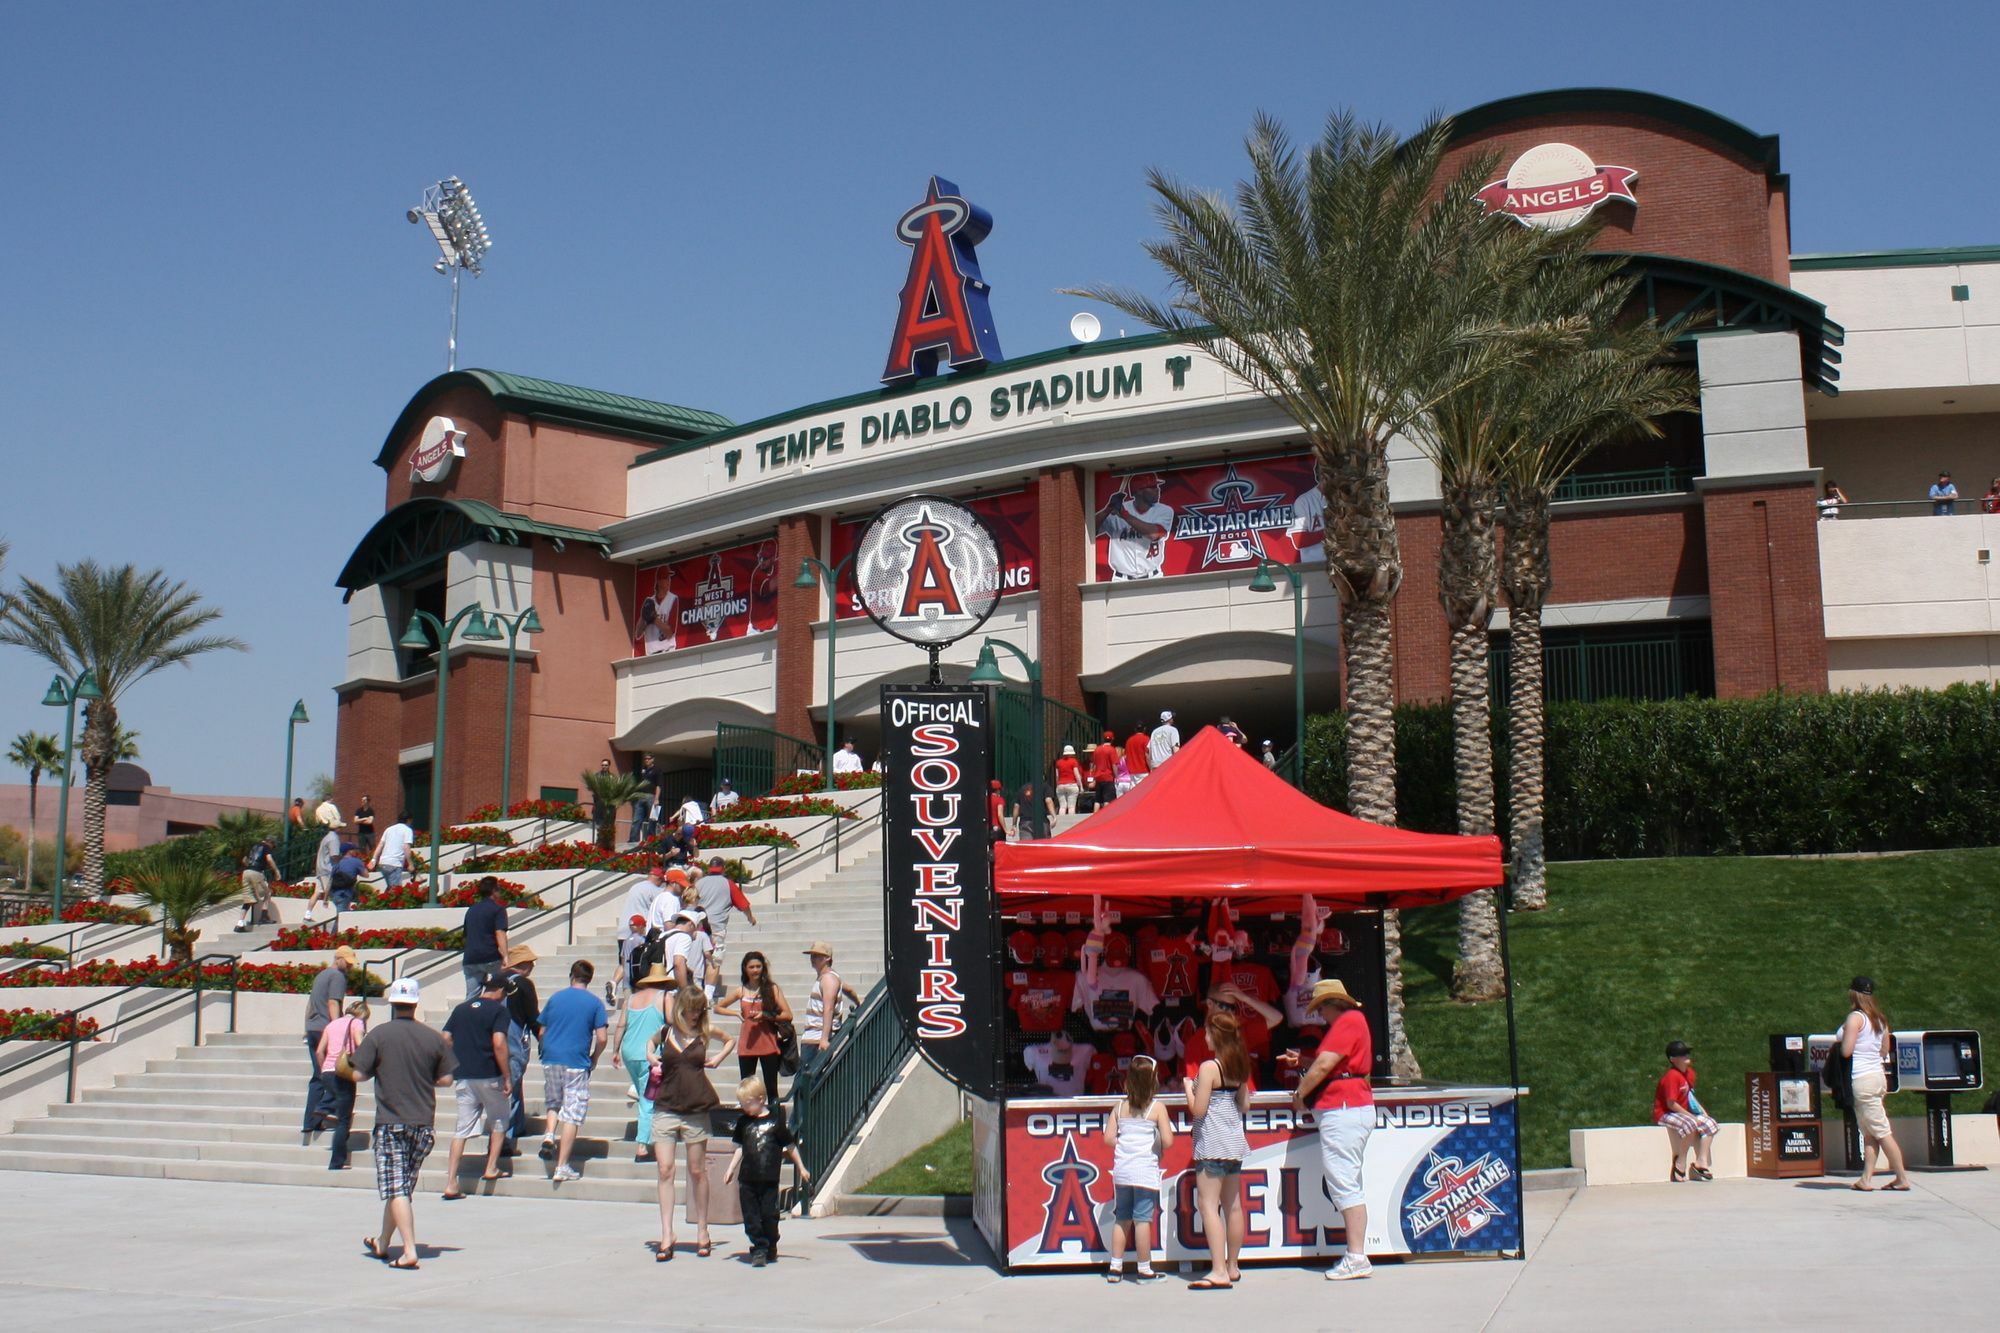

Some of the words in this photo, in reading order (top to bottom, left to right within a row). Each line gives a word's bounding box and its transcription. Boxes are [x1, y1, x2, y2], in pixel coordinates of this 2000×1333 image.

[1504, 179, 1605, 208] ANGELS
[880, 175, 985, 382] A
[756, 422, 845, 469] TEMPE
[861, 396, 973, 445] DIABLO
[991, 363, 1143, 418] STADIUM
[417, 441, 448, 467] ANGELS
[1248, 507, 1292, 530] GAME
[1220, 531, 1248, 541] 2010
[891, 506, 972, 620] A
[704, 590, 725, 602] WEST
[681, 598, 748, 625] CHAMPIONS
[892, 699, 980, 728] OFFICIAL
[910, 723, 967, 1038] SOUVENIRS
[1900, 1058, 1919, 1069] ODAY
[1902, 1048, 1917, 1058] USA
[1752, 1077, 1760, 1134] ARIZONA
[1762, 1090, 1772, 1151] REPUBLIC
[1753, 1137, 1762, 1164] THE
[1466, 1161, 1507, 1196] GAME
[1367, 1236, 1381, 1245] TM
